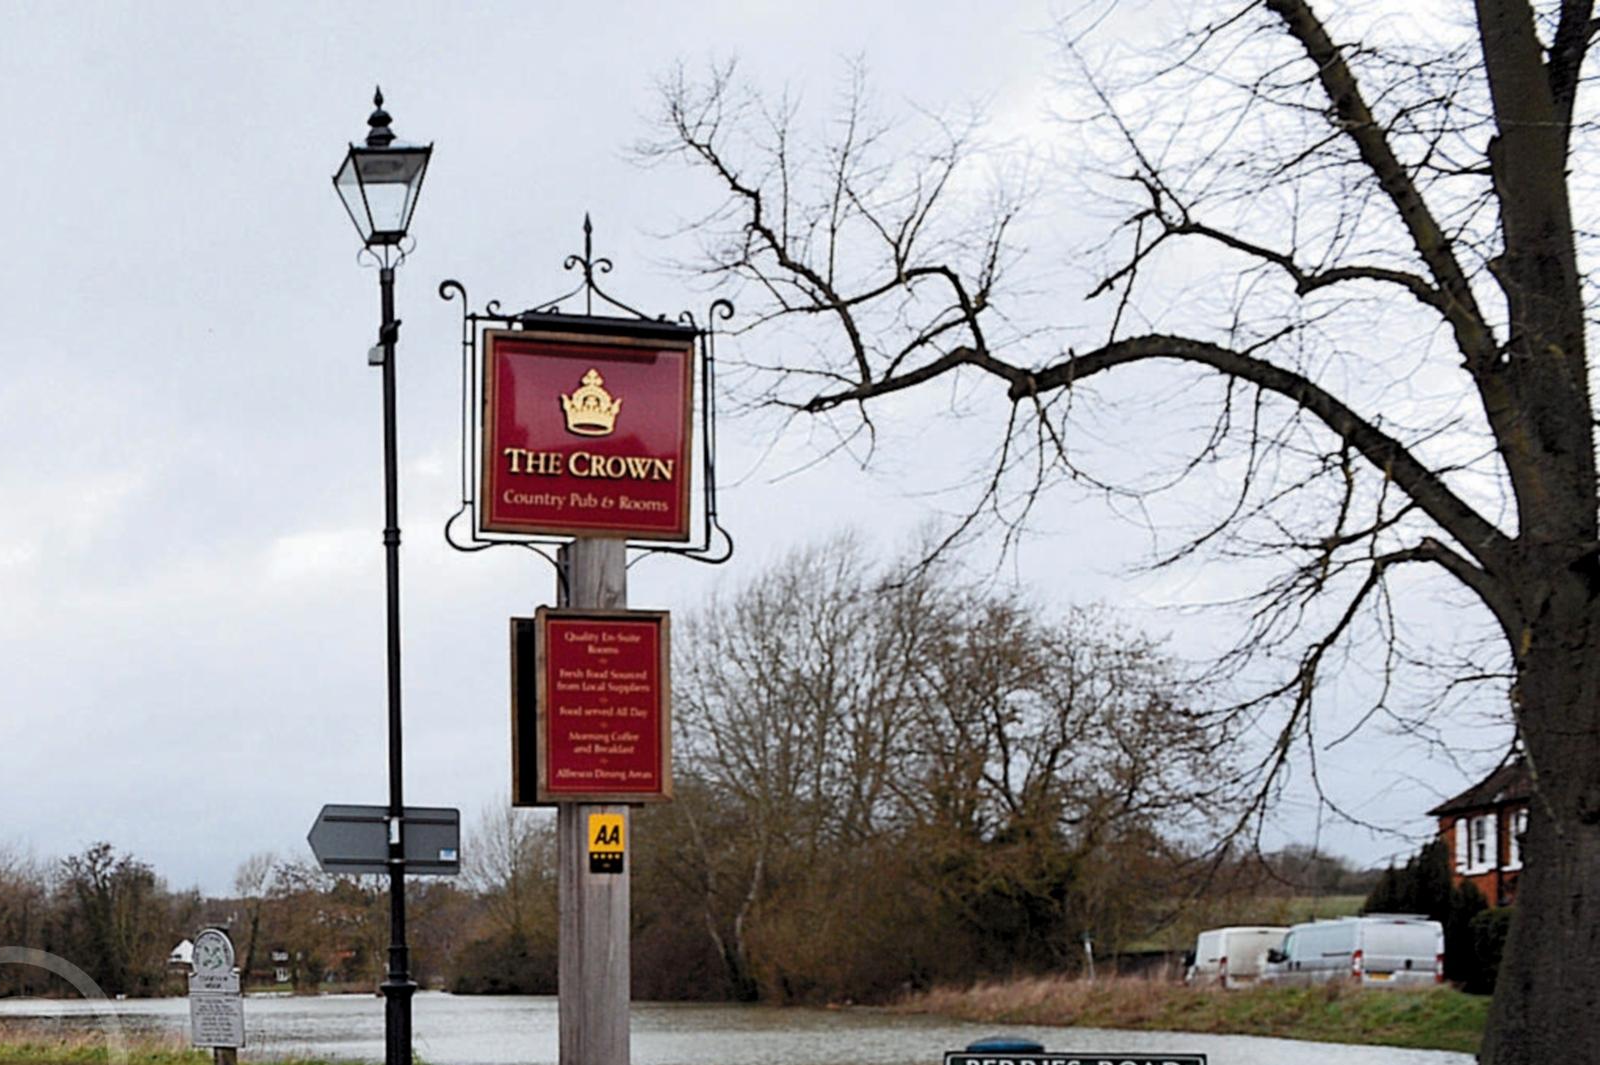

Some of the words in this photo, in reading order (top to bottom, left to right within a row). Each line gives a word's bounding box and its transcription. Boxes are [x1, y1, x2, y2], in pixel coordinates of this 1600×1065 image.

[504, 448, 562, 475] THE
[568, 452, 674, 480] CROWN
[503, 489, 565, 510] Country
[570, 491, 597, 508] Pub
[600, 495, 614, 509] &
[618, 496, 669, 512] Rooms
[564, 631, 599, 644] Quality
[588, 644, 619, 654] Rooms
[559, 668, 584, 678] Fresh
[586, 668, 608, 679] Food
[610, 669, 647, 680] Sourced
[556, 681, 580, 690] from
[582, 681, 606, 691] Local
[608, 682, 650, 695] Suppliers
[559, 706, 582, 716] Food
[615, 707, 628, 717] All
[630, 707, 648, 718] Day
[569, 731, 609, 743] Morning
[611, 731, 639, 741] Coffee
[573, 744, 592, 753] and
[594, 744, 634, 754] Breakfast
[594, 769, 626, 780] Dining
[594, 824, 620, 845] AA
